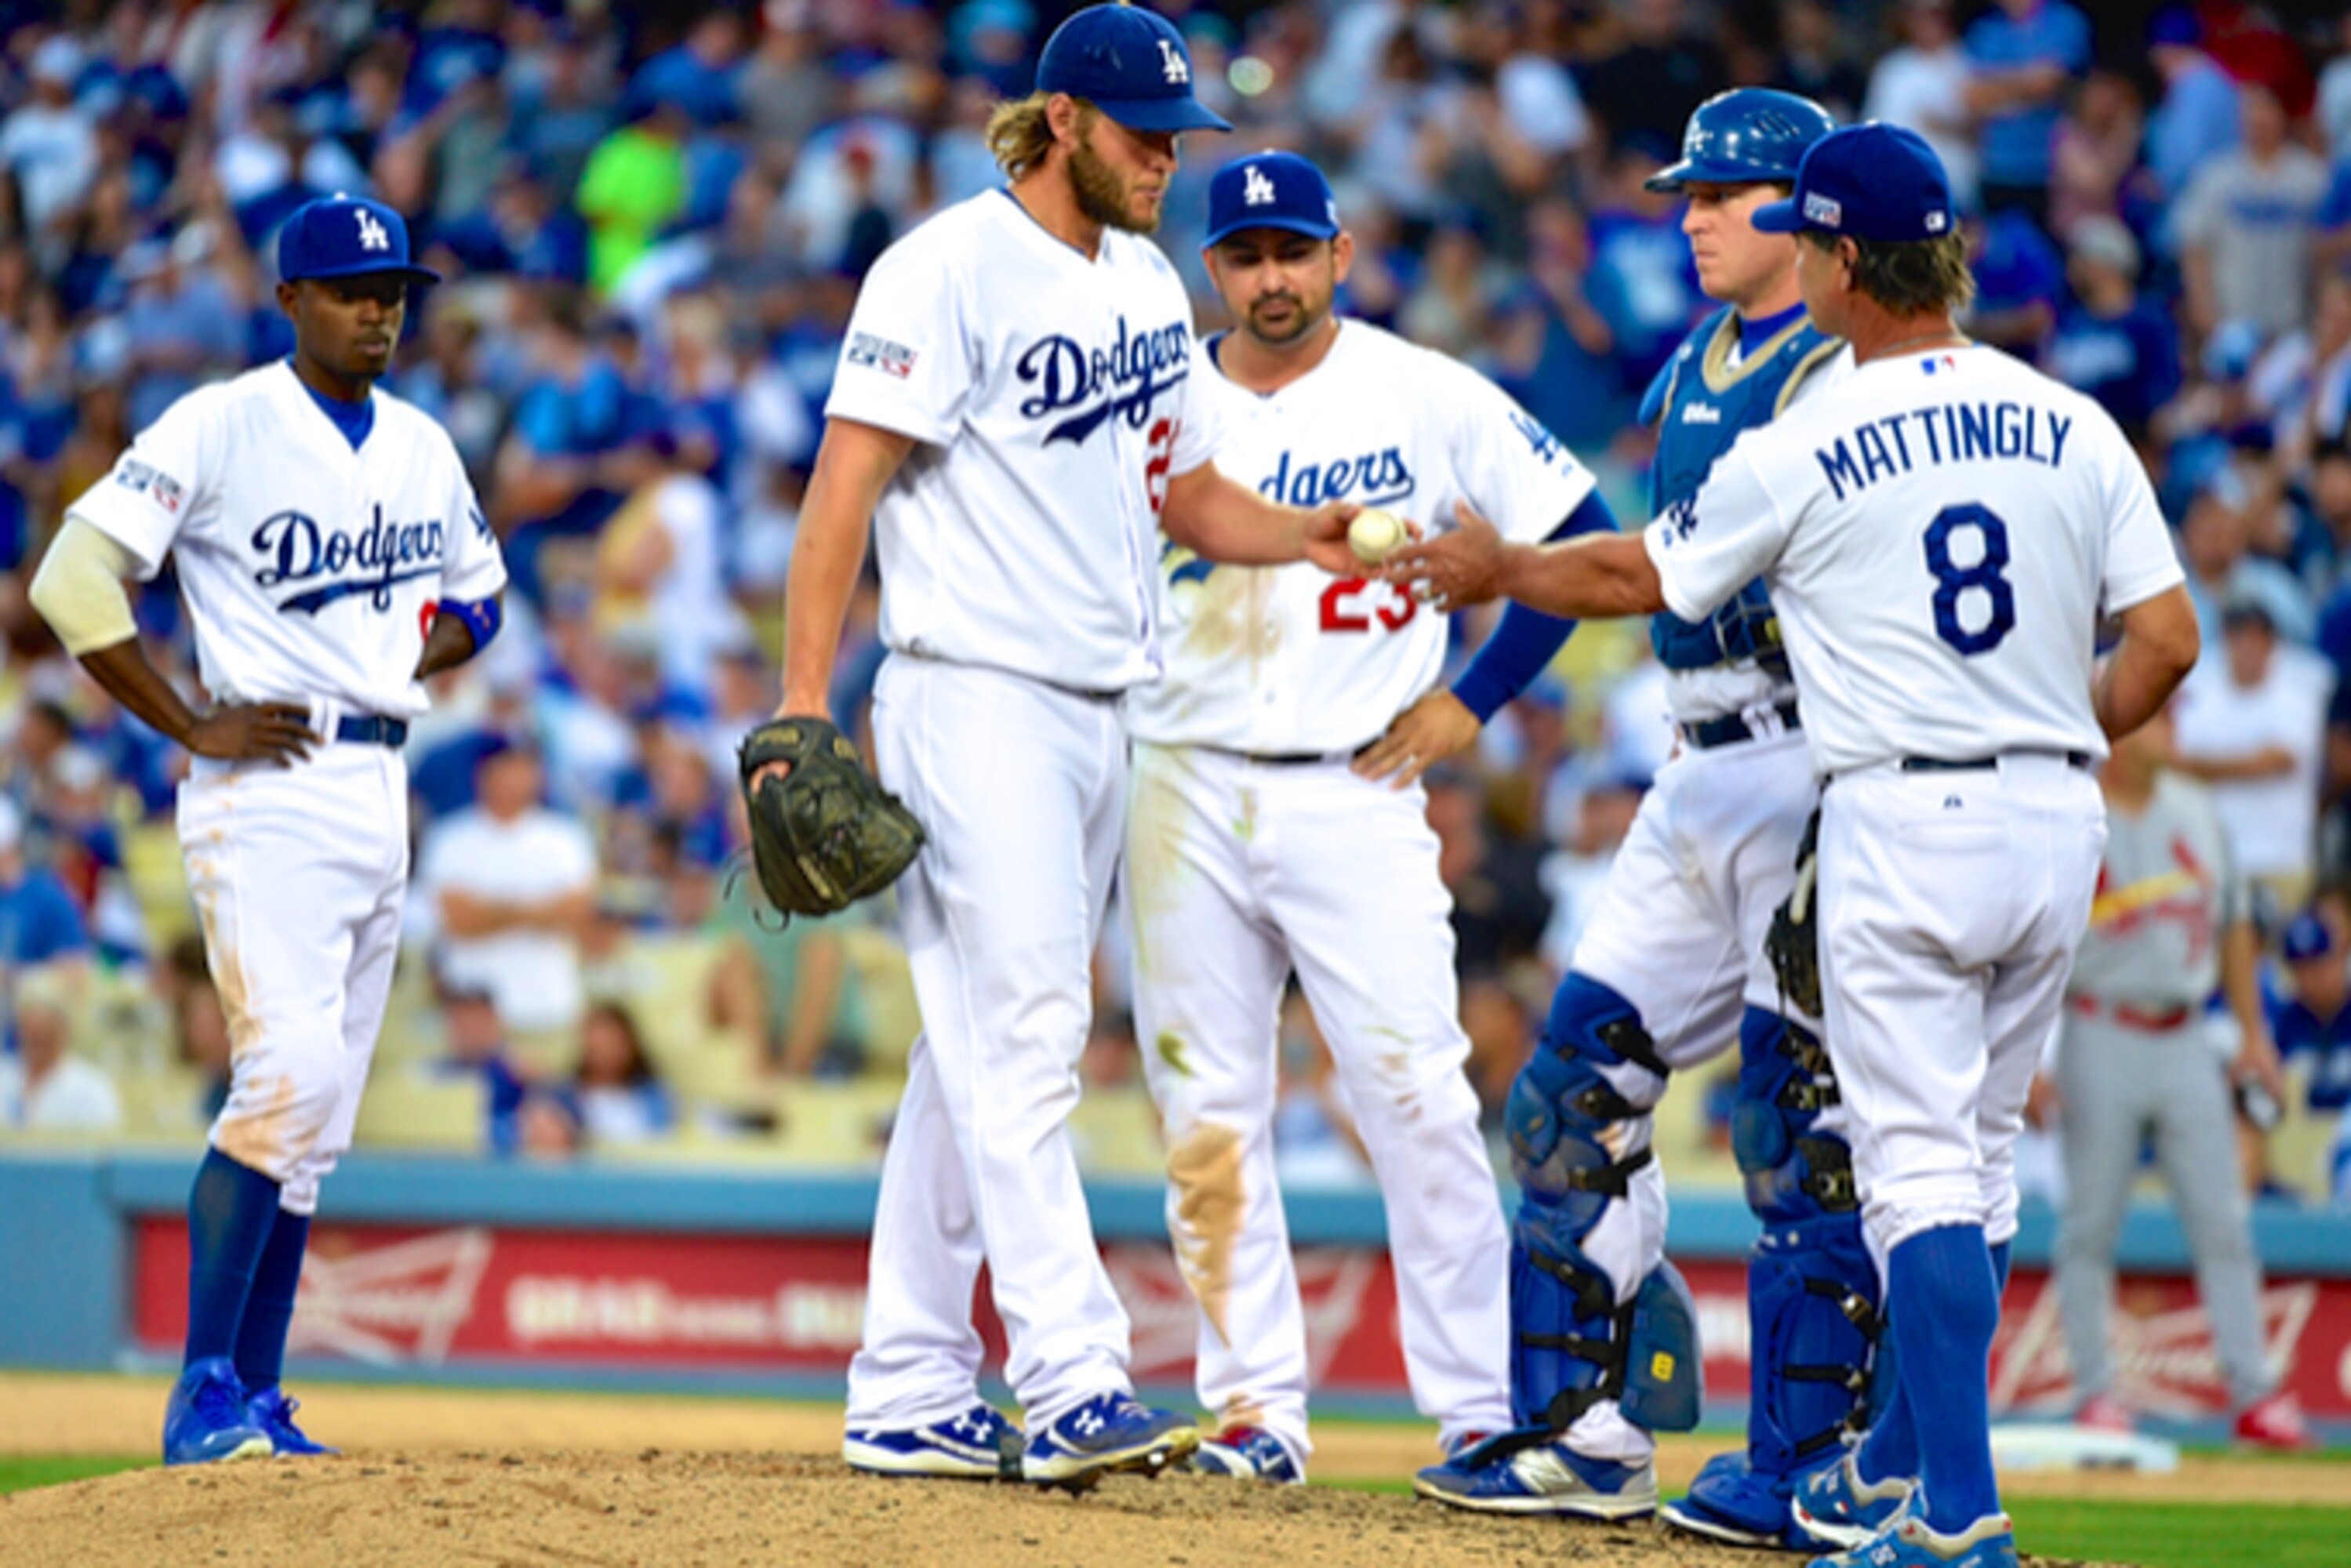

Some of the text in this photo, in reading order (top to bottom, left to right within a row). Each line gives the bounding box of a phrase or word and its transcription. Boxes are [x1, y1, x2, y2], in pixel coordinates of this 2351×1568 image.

[1157, 40, 1189, 83] LA
[1244, 165, 1276, 205] LA
[355, 209, 390, 250] LA
[1814, 401, 2072, 502] MATTINGLY
[1923, 500, 2016, 655] 8
[1319, 575, 1418, 633] 23
